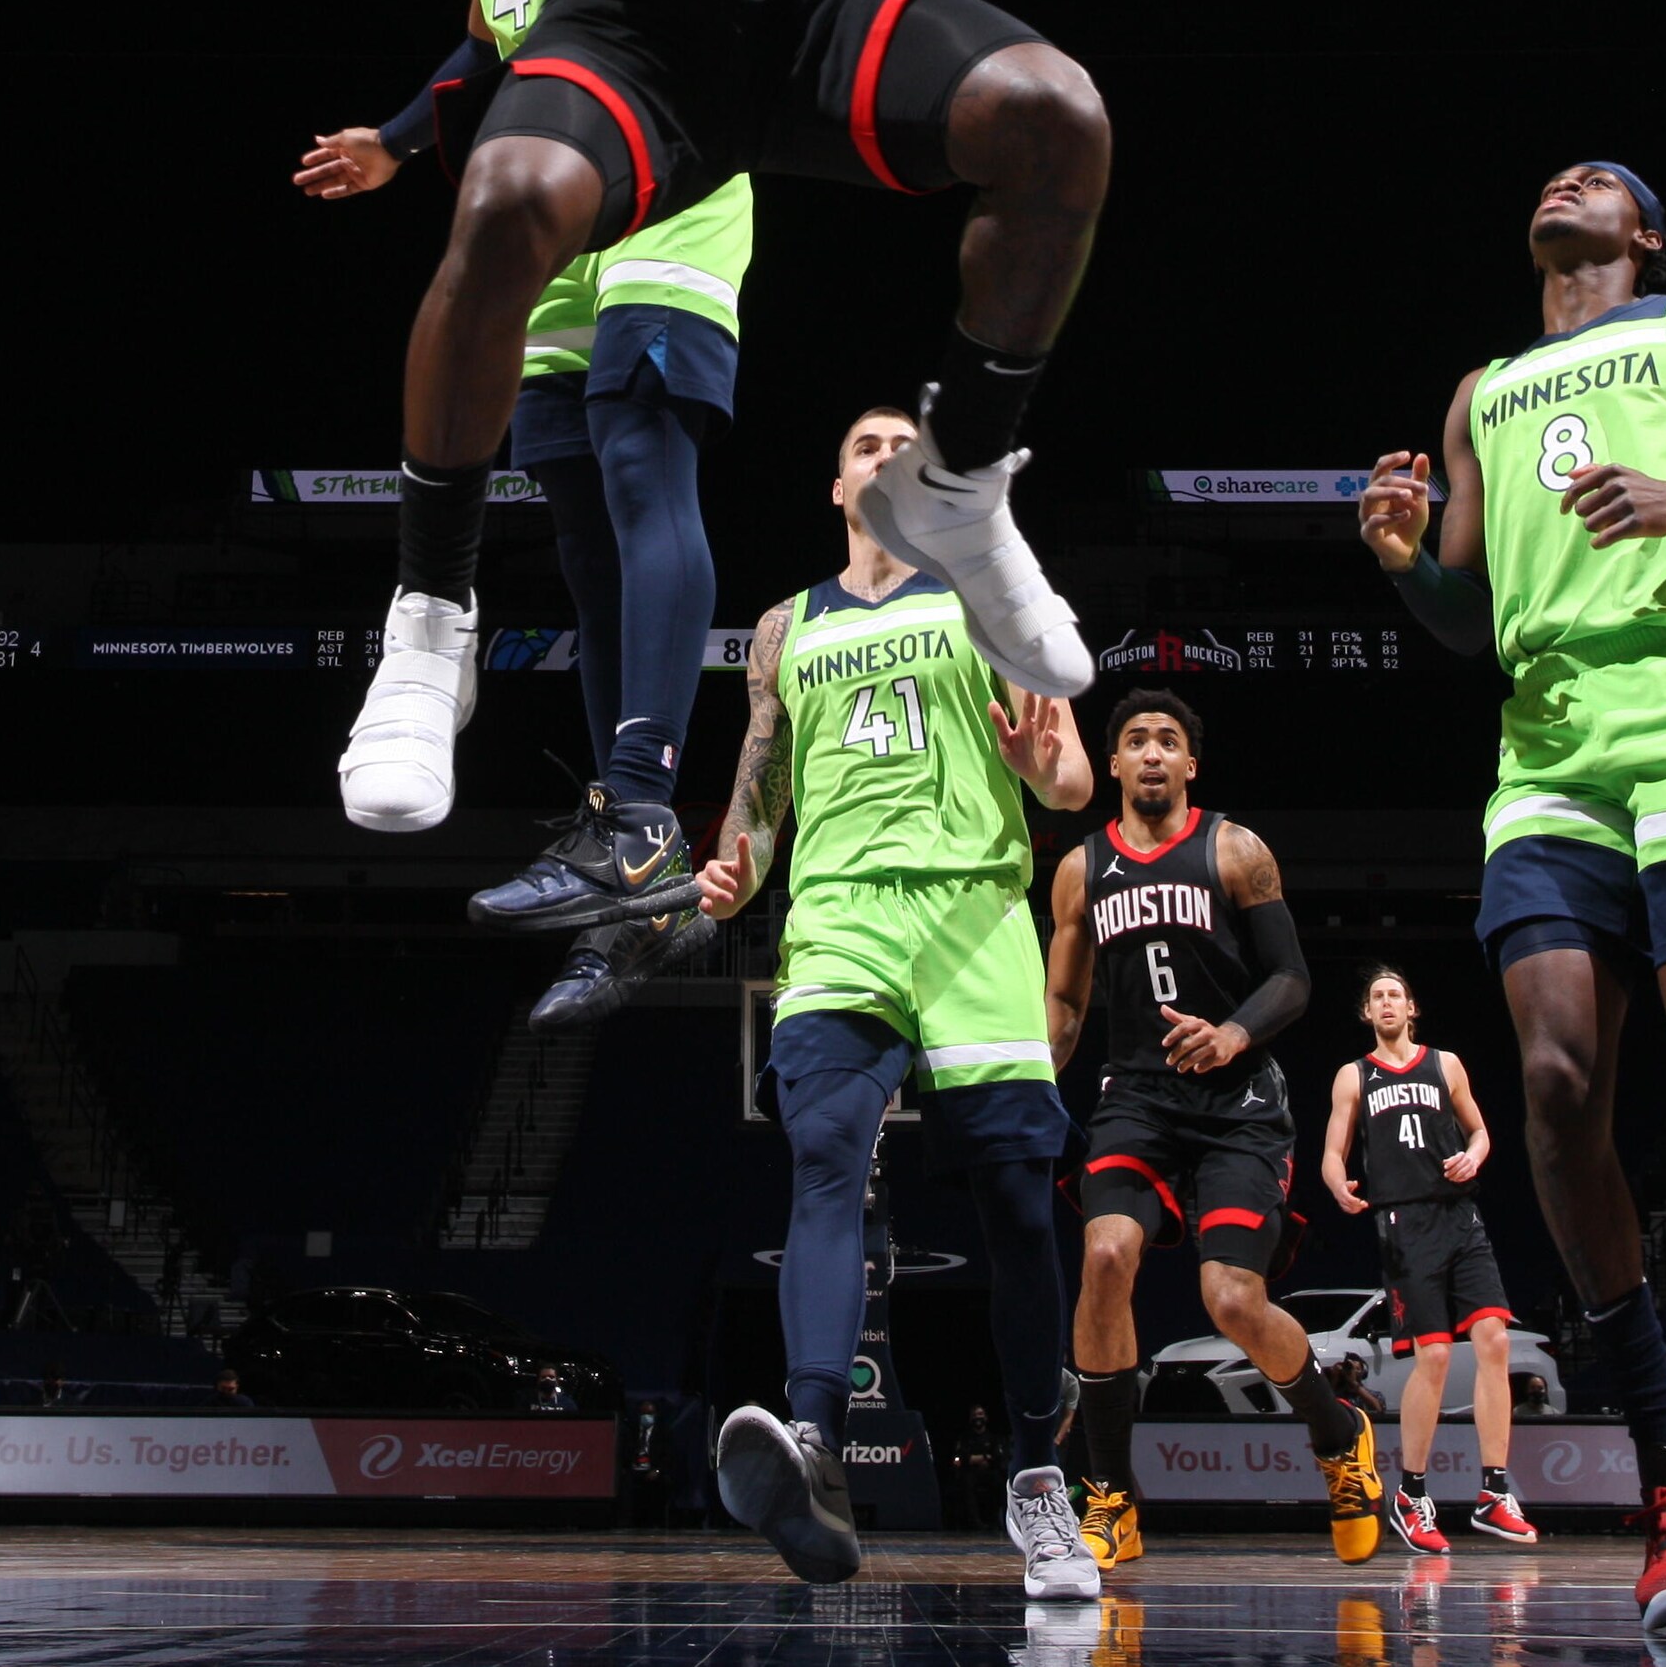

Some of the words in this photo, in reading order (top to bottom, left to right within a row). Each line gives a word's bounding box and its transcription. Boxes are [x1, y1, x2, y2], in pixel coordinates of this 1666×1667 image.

[1481, 351, 1660, 438] MINNESOTA
[1537, 413, 1593, 492] 8
[1217, 476, 1318, 495] sharecare
[317, 630, 345, 641] REB
[365, 630, 380, 641] 31
[1247, 632, 1274, 642] REB
[1298, 631, 1313, 641] 31
[1332, 632, 1362, 643] FG%
[1381, 632, 1397, 641] 55
[30, 642, 42, 657] 4
[93, 642, 177, 654] MINNESOTA
[180, 642, 294, 655] TIMBERWOLVES
[317, 644, 343, 654] AST
[365, 643, 380, 654] 21
[1106, 645, 1156, 669] HOUSTON
[1184, 645, 1234, 669] ROCKETS
[1247, 646, 1274, 656] AST
[1298, 645, 1313, 656] 21
[1333, 645, 1362, 656] FT%
[1381, 645, 1398, 656] 83
[317, 656, 343, 668] STL
[367, 658, 376, 668] 8
[797, 629, 955, 694] MINNESOTA
[1249, 658, 1275, 669] STL
[1304, 659, 1312, 669] 7
[1331, 658, 1368, 669] 3PT%
[1382, 658, 1399, 669] 52
[842, 674, 927, 758] 41
[1093, 883, 1213, 946] HOUSTON
[1145, 940, 1178, 1003] 6
[1368, 1083, 1440, 1117] HOUSTON
[1399, 1113, 1425, 1150] 41
[860, 1330, 885, 1342] itbit
[65, 1437, 120, 1466] Us.
[130, 1437, 290, 1473] Together.
[842, 1441, 900, 1464] rizon
[1157, 1443, 1231, 1472] You.
[1244, 1443, 1300, 1472] Us.
